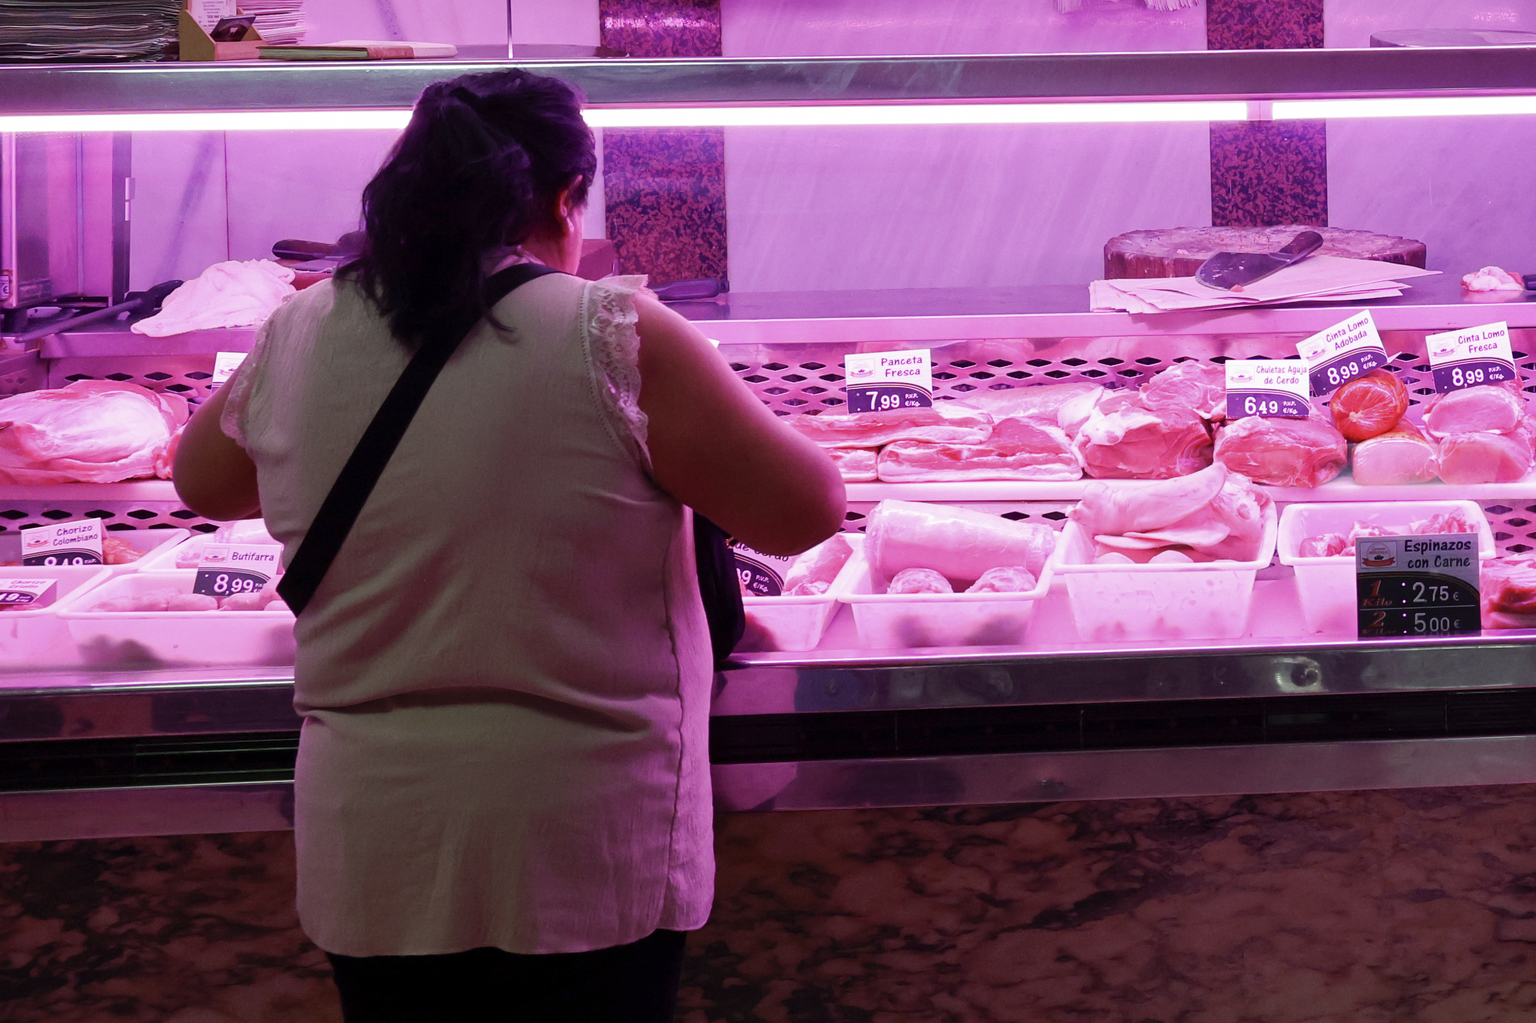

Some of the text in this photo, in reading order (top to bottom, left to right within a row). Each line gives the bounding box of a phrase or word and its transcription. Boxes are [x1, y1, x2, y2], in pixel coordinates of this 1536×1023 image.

[1326, 318, 1368, 342] Cinta Lomo
[1458, 330, 1505, 344] Cinta Lomo
[1334, 330, 1368, 350] Adobada
[1468, 342, 1498, 354] Fresca
[881, 356, 922, 366] Panceta
[885, 368, 921, 378] Fresca
[1256, 366, 1307, 376] Chuletas Aguja
[1328, 362, 1358, 384] 8,99
[1452, 368, 1484, 388] 8,99
[1276, 376, 1300, 384] Cerdo
[866, 392, 900, 411] 7,99
[1244, 396, 1278, 416] 6,49
[56, 526, 92, 536] Chorizo
[53, 534, 98, 546] Colombiano
[1404, 540, 1471, 555] Espinazos
[232, 552, 274, 562] Butifarra
[1408, 555, 1470, 568] con Carne
[214, 574, 254, 596] 8,99
[1370, 580, 1382, 597] 1
[1453, 592, 1459, 601] €
[1362, 598, 1392, 606] Kilo
[1370, 611, 1386, 627] 2
[1454, 619, 1460, 628] €
